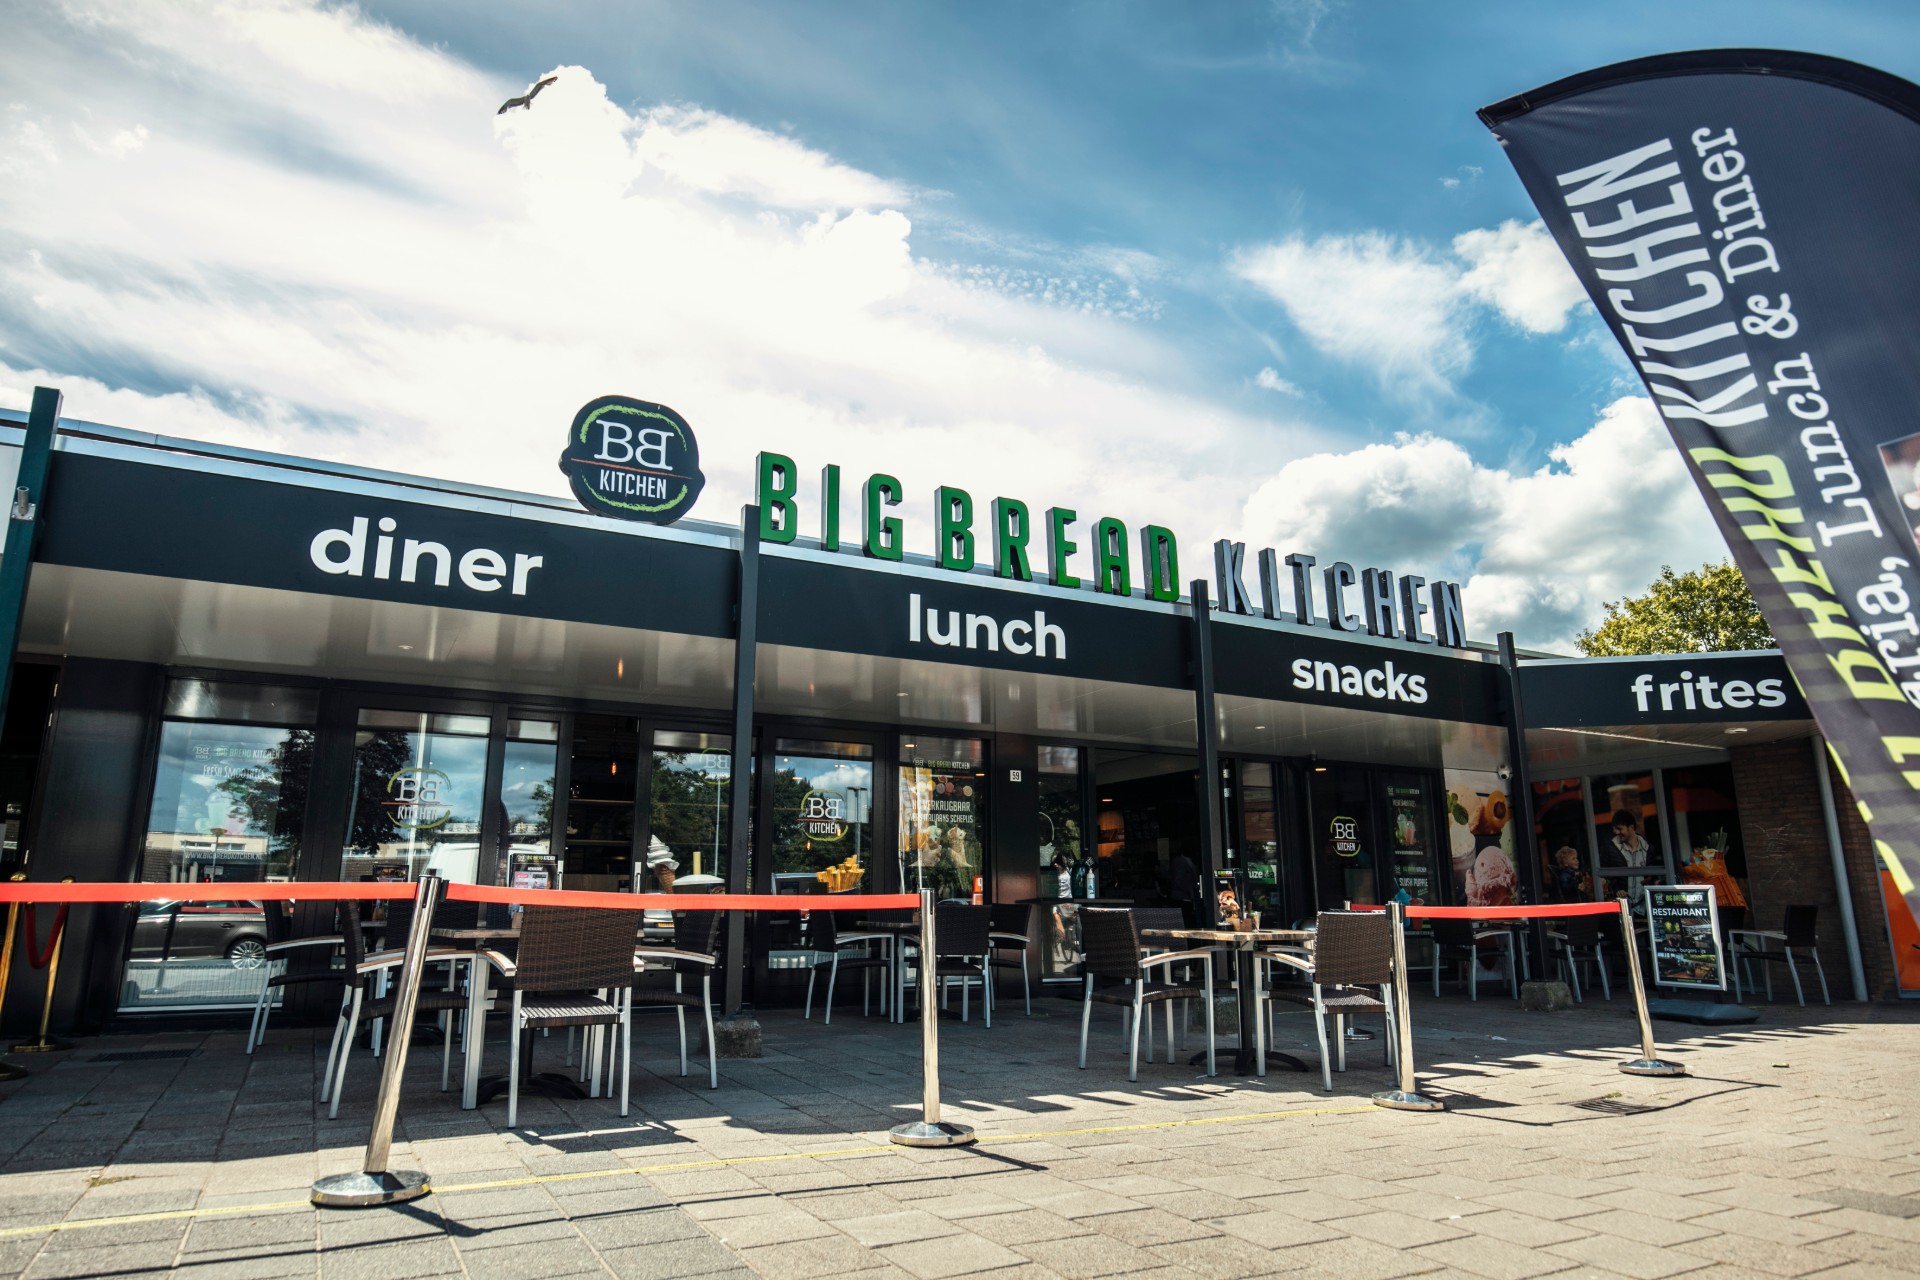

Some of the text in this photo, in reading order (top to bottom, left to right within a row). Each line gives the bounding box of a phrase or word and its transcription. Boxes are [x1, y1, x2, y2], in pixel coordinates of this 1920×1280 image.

[1691, 127, 1780, 284] Diner
[1556, 138, 1769, 428] KITCHEN
[1742, 293, 1799, 340] &
[1767, 352, 1883, 547] Lunch
[600, 469, 667, 500] KITCHEN
[310, 516, 544, 596] diner
[755, 450, 1467, 648] BIG BREAD KITCHEN
[909, 593, 1067, 660] lunch
[1291, 658, 1429, 704] snacks
[1631, 670, 1787, 712] frites
[203, 764, 222, 777] FRESH
[252, 749, 280, 759] KITCHEN
[951, 761, 970, 769] KITCHEN
[1012, 771, 1020, 780] 59
[397, 806, 438, 820] KITCHEN
[809, 822, 840, 834] KITCHEN
[1652, 908, 1708, 917] RESTAURANT
